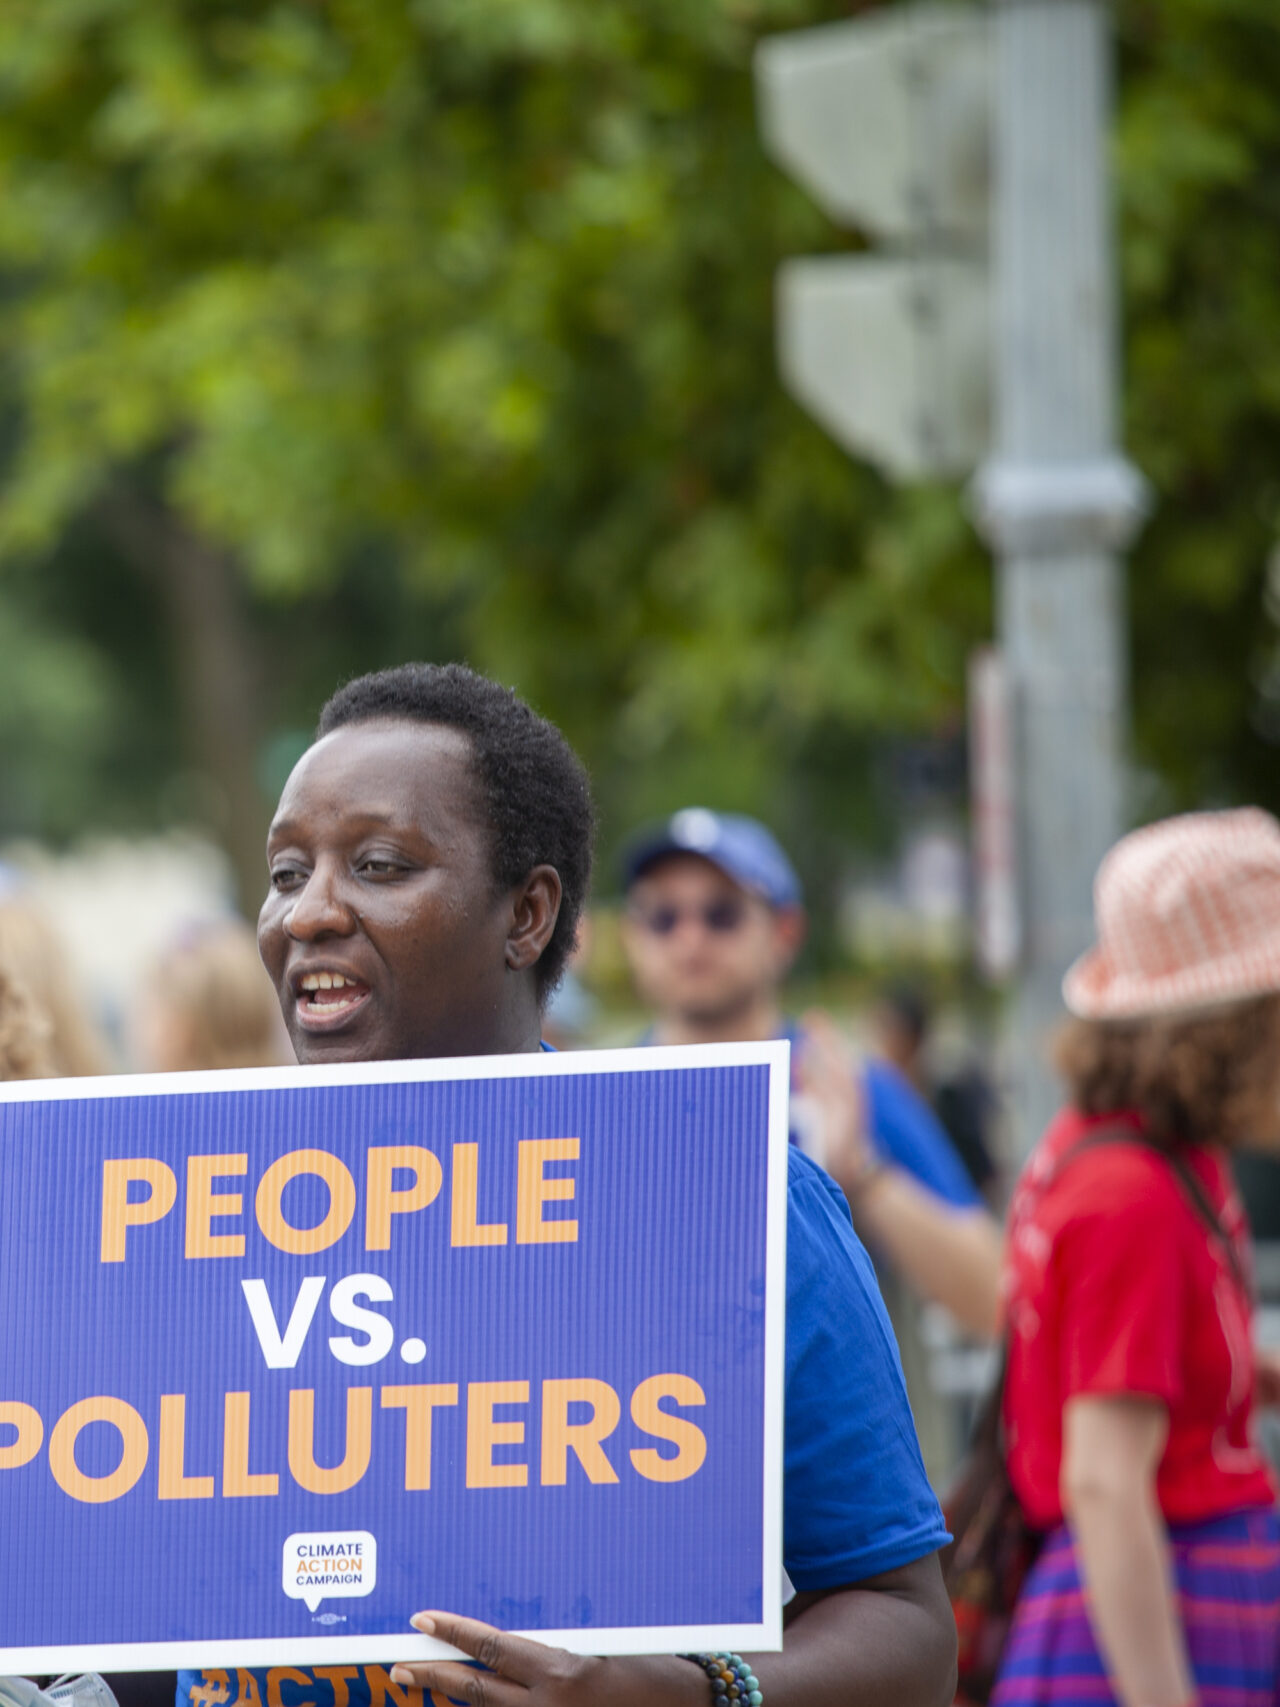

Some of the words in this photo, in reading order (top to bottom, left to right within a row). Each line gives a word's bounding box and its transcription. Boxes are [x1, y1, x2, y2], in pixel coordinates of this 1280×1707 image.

[100, 1137, 581, 1263] PEOPLE
[241, 1273, 427, 1370] VS.
[297, 1542, 363, 1557] CLIMATE
[297, 1558, 362, 1573] ACTION
[296, 1573, 362, 1585] CAMPAIGN
